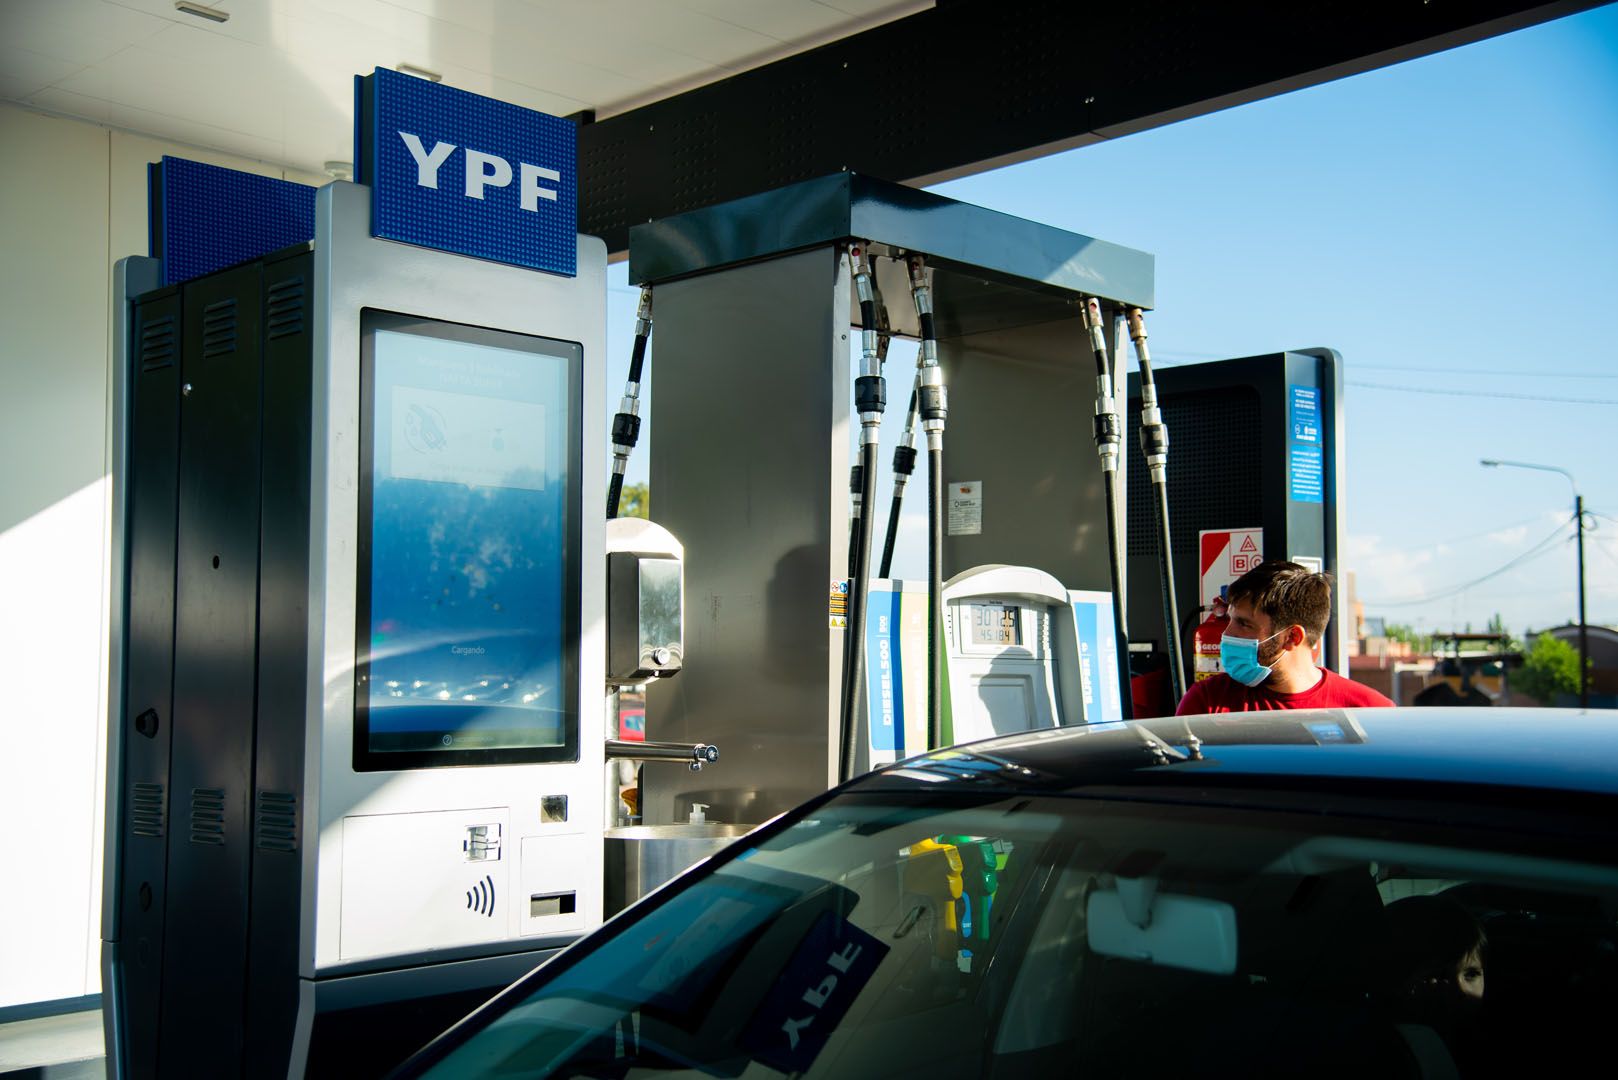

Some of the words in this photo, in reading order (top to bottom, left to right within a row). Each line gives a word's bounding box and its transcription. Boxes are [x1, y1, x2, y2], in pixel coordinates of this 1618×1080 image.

[397, 130, 561, 213] YPF
[1236, 559, 1245, 568] B
[451, 645, 485, 656] Cargando
